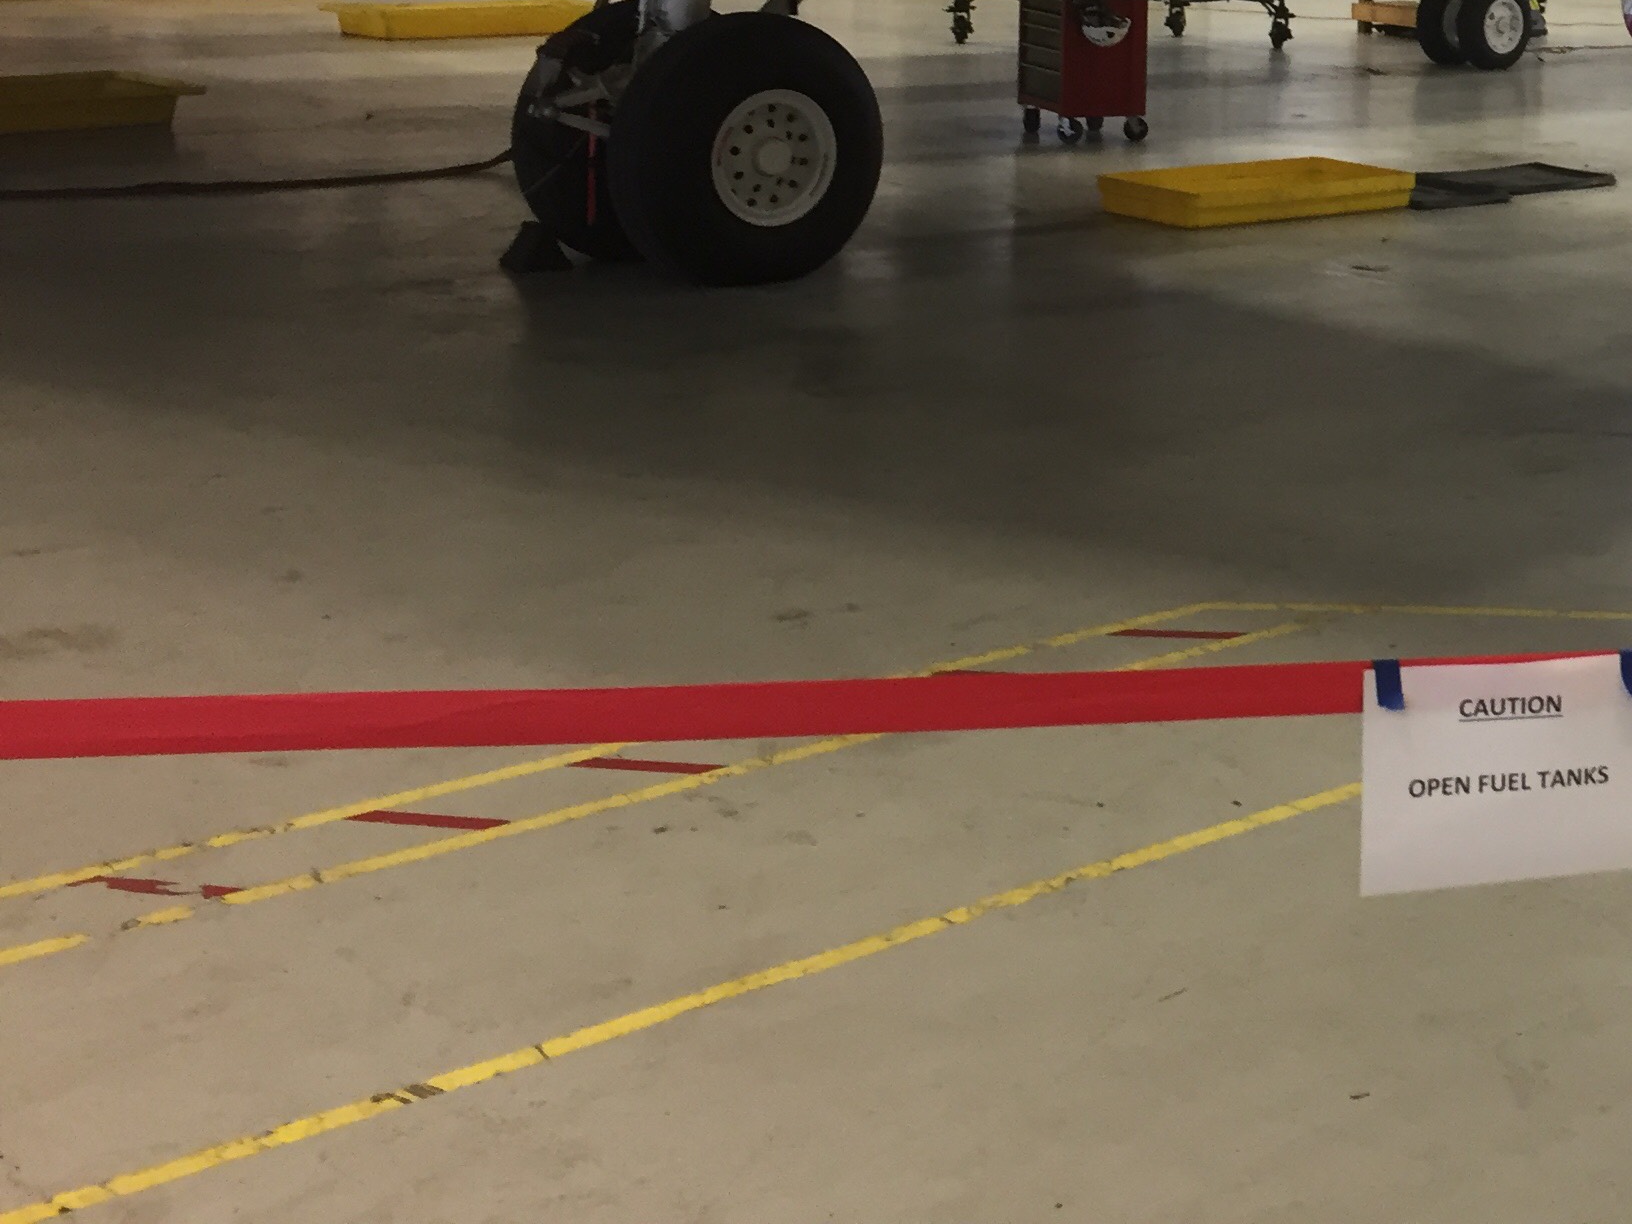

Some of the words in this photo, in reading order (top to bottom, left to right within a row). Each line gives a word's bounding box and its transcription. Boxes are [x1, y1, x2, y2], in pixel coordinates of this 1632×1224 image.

[1458, 694, 1563, 719] CAUTION
[1408, 776, 1471, 798] OPEN
[1478, 772, 1532, 794] FUEL
[1537, 765, 1609, 789] TANKS
